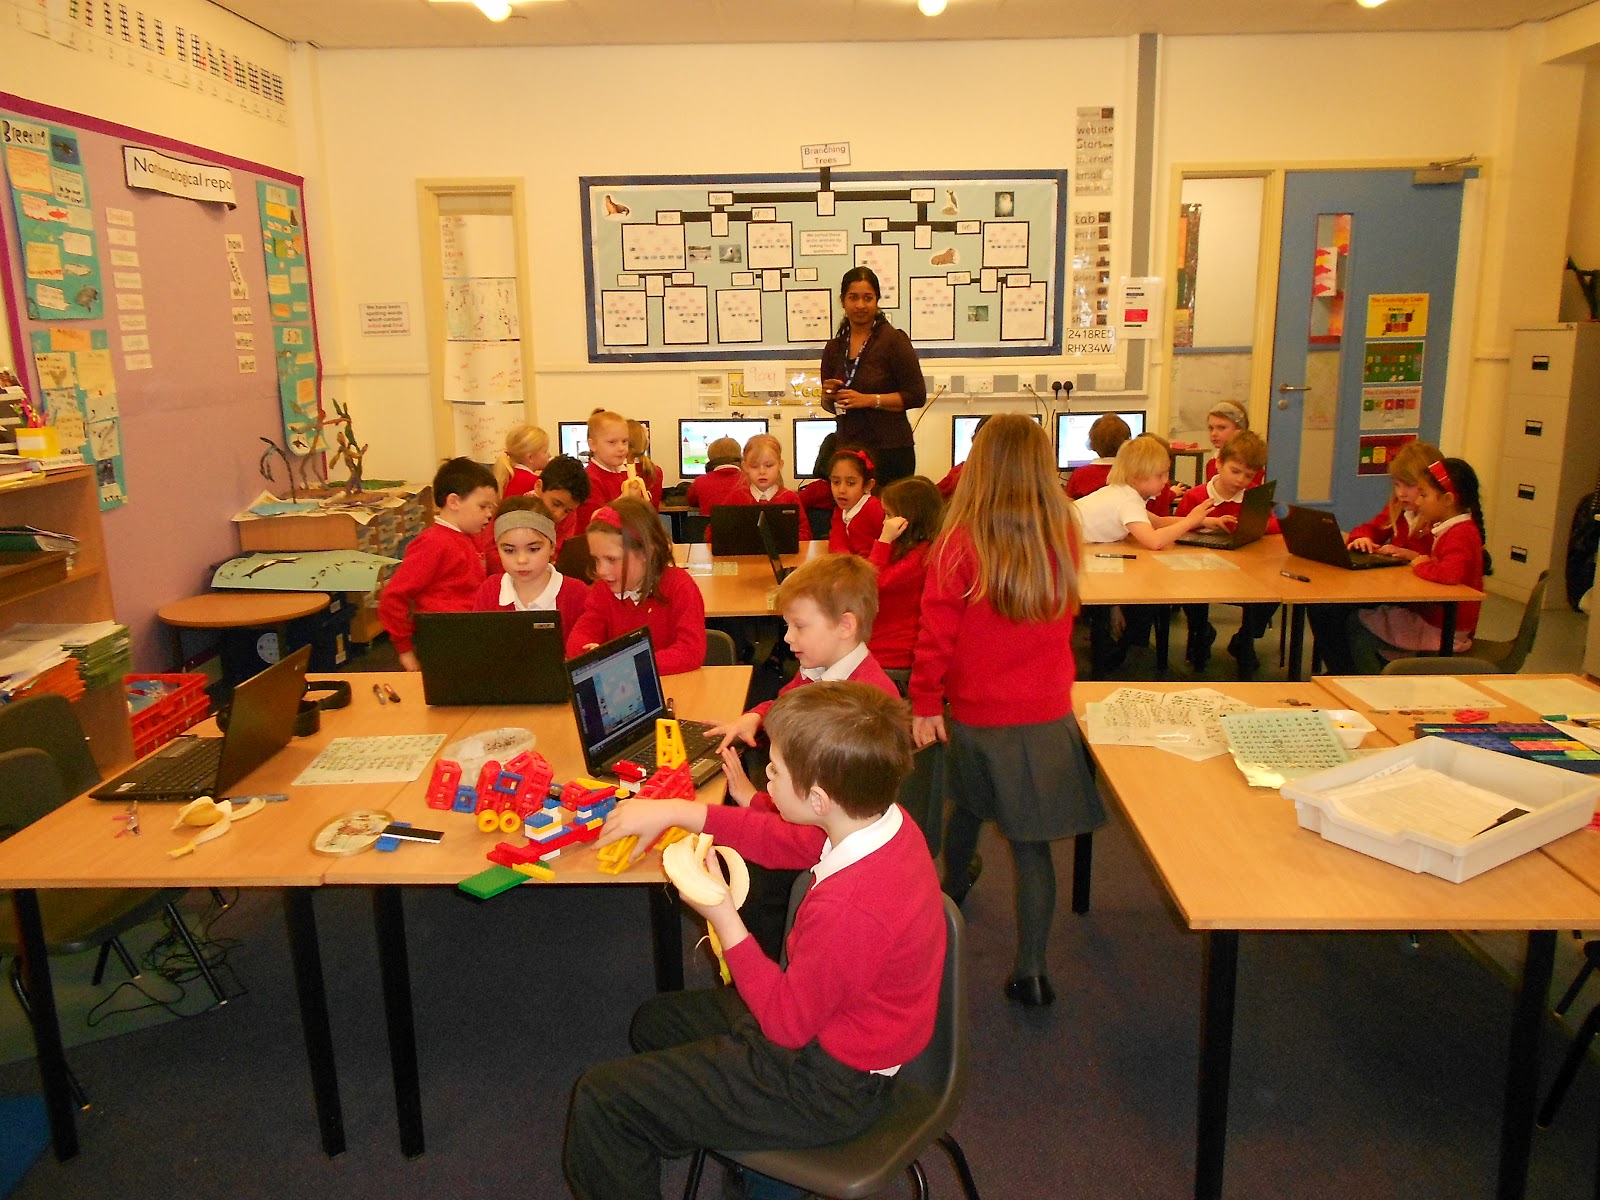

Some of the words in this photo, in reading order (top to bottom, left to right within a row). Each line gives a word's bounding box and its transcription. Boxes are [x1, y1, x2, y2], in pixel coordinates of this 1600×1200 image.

[1076, 124, 1114, 134] website
[1076, 138, 1102, 149] Start
[804, 146, 846, 155] Branching
[814, 157, 838, 165] Trees
[1075, 211, 1096, 225] tab
[227, 237, 242, 250] how
[1068, 329, 1114, 339] 2418RED
[1067, 343, 1113, 353] RHX34W
